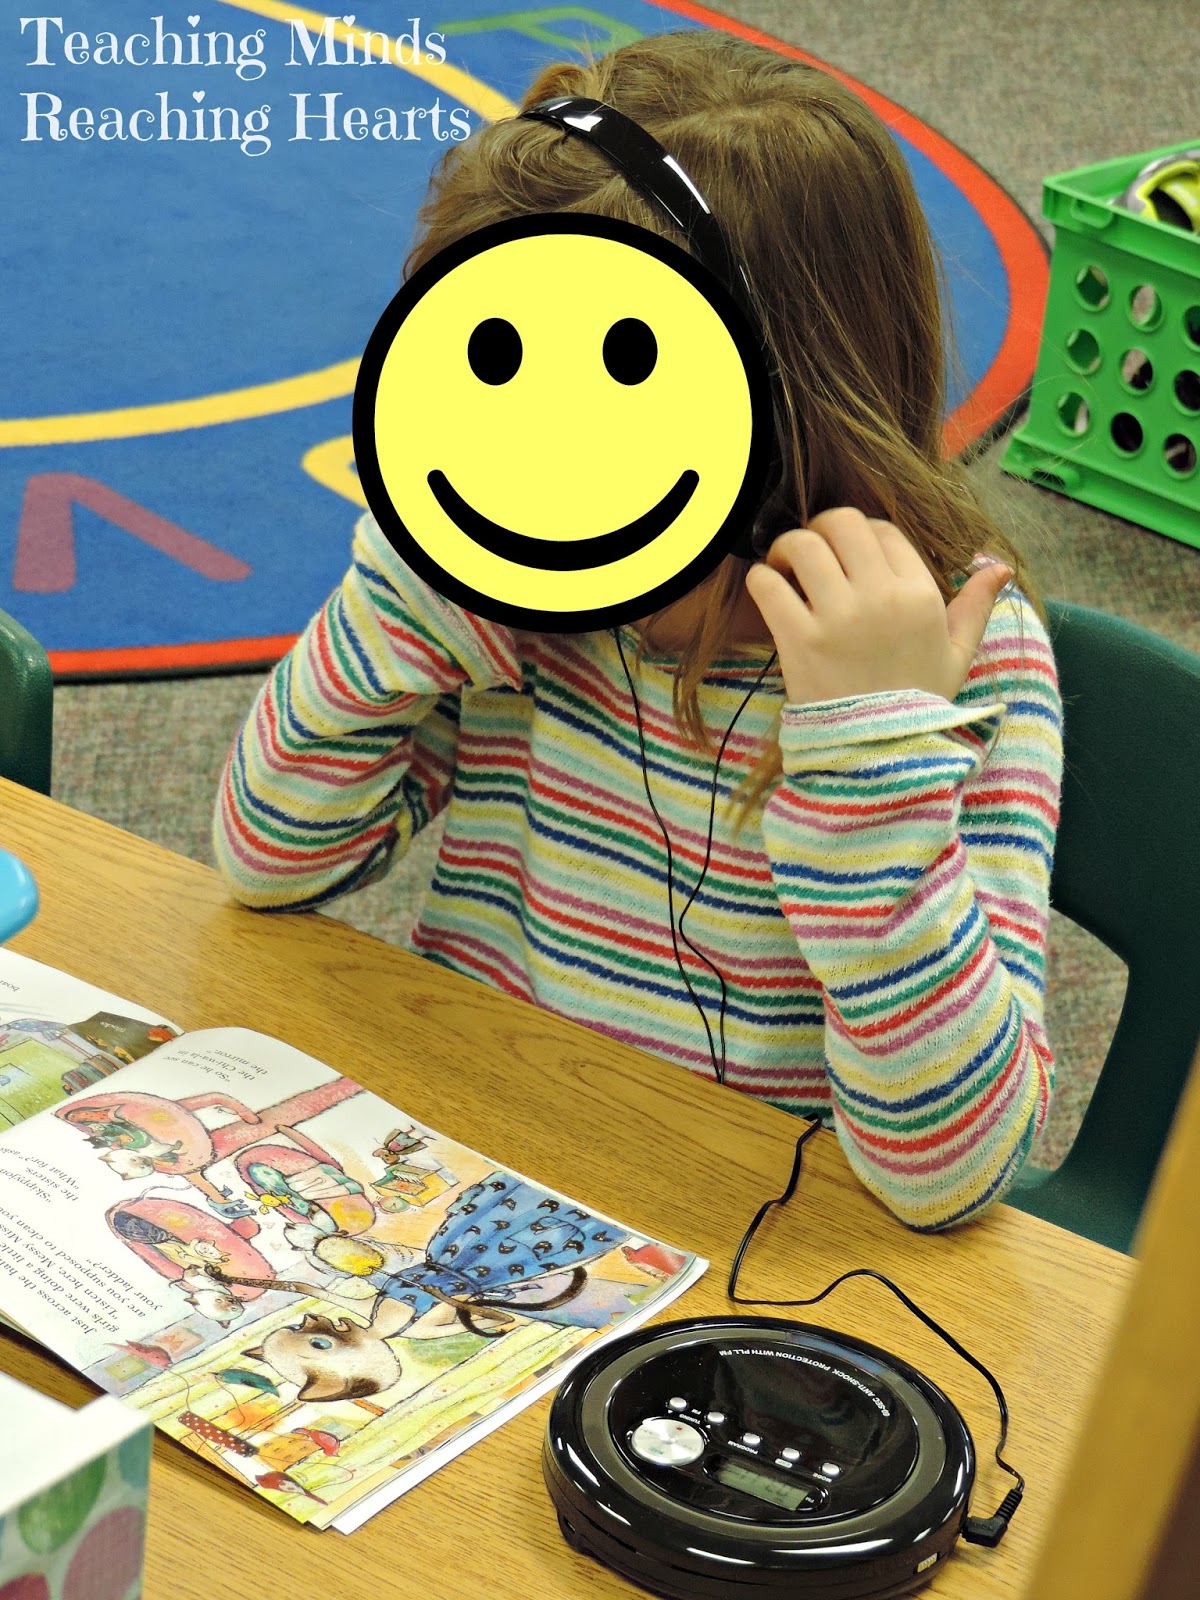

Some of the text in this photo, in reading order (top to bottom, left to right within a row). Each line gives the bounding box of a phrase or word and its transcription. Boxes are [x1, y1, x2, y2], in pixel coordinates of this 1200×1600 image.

[238, 1070, 255, 1081] the
[251, 1065, 268, 1075] the
[60, 1188, 79, 1201] the
[16, 1220, 44, 1240] clean
[0, 1243, 25, 1263] little
[44, 1241, 57, 1250] to
[22, 1243, 56, 1268] Messy
[33, 1267, 64, 1291] doing
[55, 1251, 106, 1288] supposed
[18, 1275, 37, 1289] the
[37, 1289, 71, 1316] across
[65, 1293, 90, 1313] were
[107, 1288, 130, 1303] you
[133, 1292, 163, 1311] your
[127, 1304, 146, 1317] are
[71, 1316, 97, 1335] Just
[92, 1313, 120, 1333] girls
[775, 1351, 831, 1371] PROTECTION
[832, 1368, 876, 1397] ANTI-SHOCK
[727, 1440, 758, 1455] PROGRAM
[812, 1472, 832, 1483] MODE
